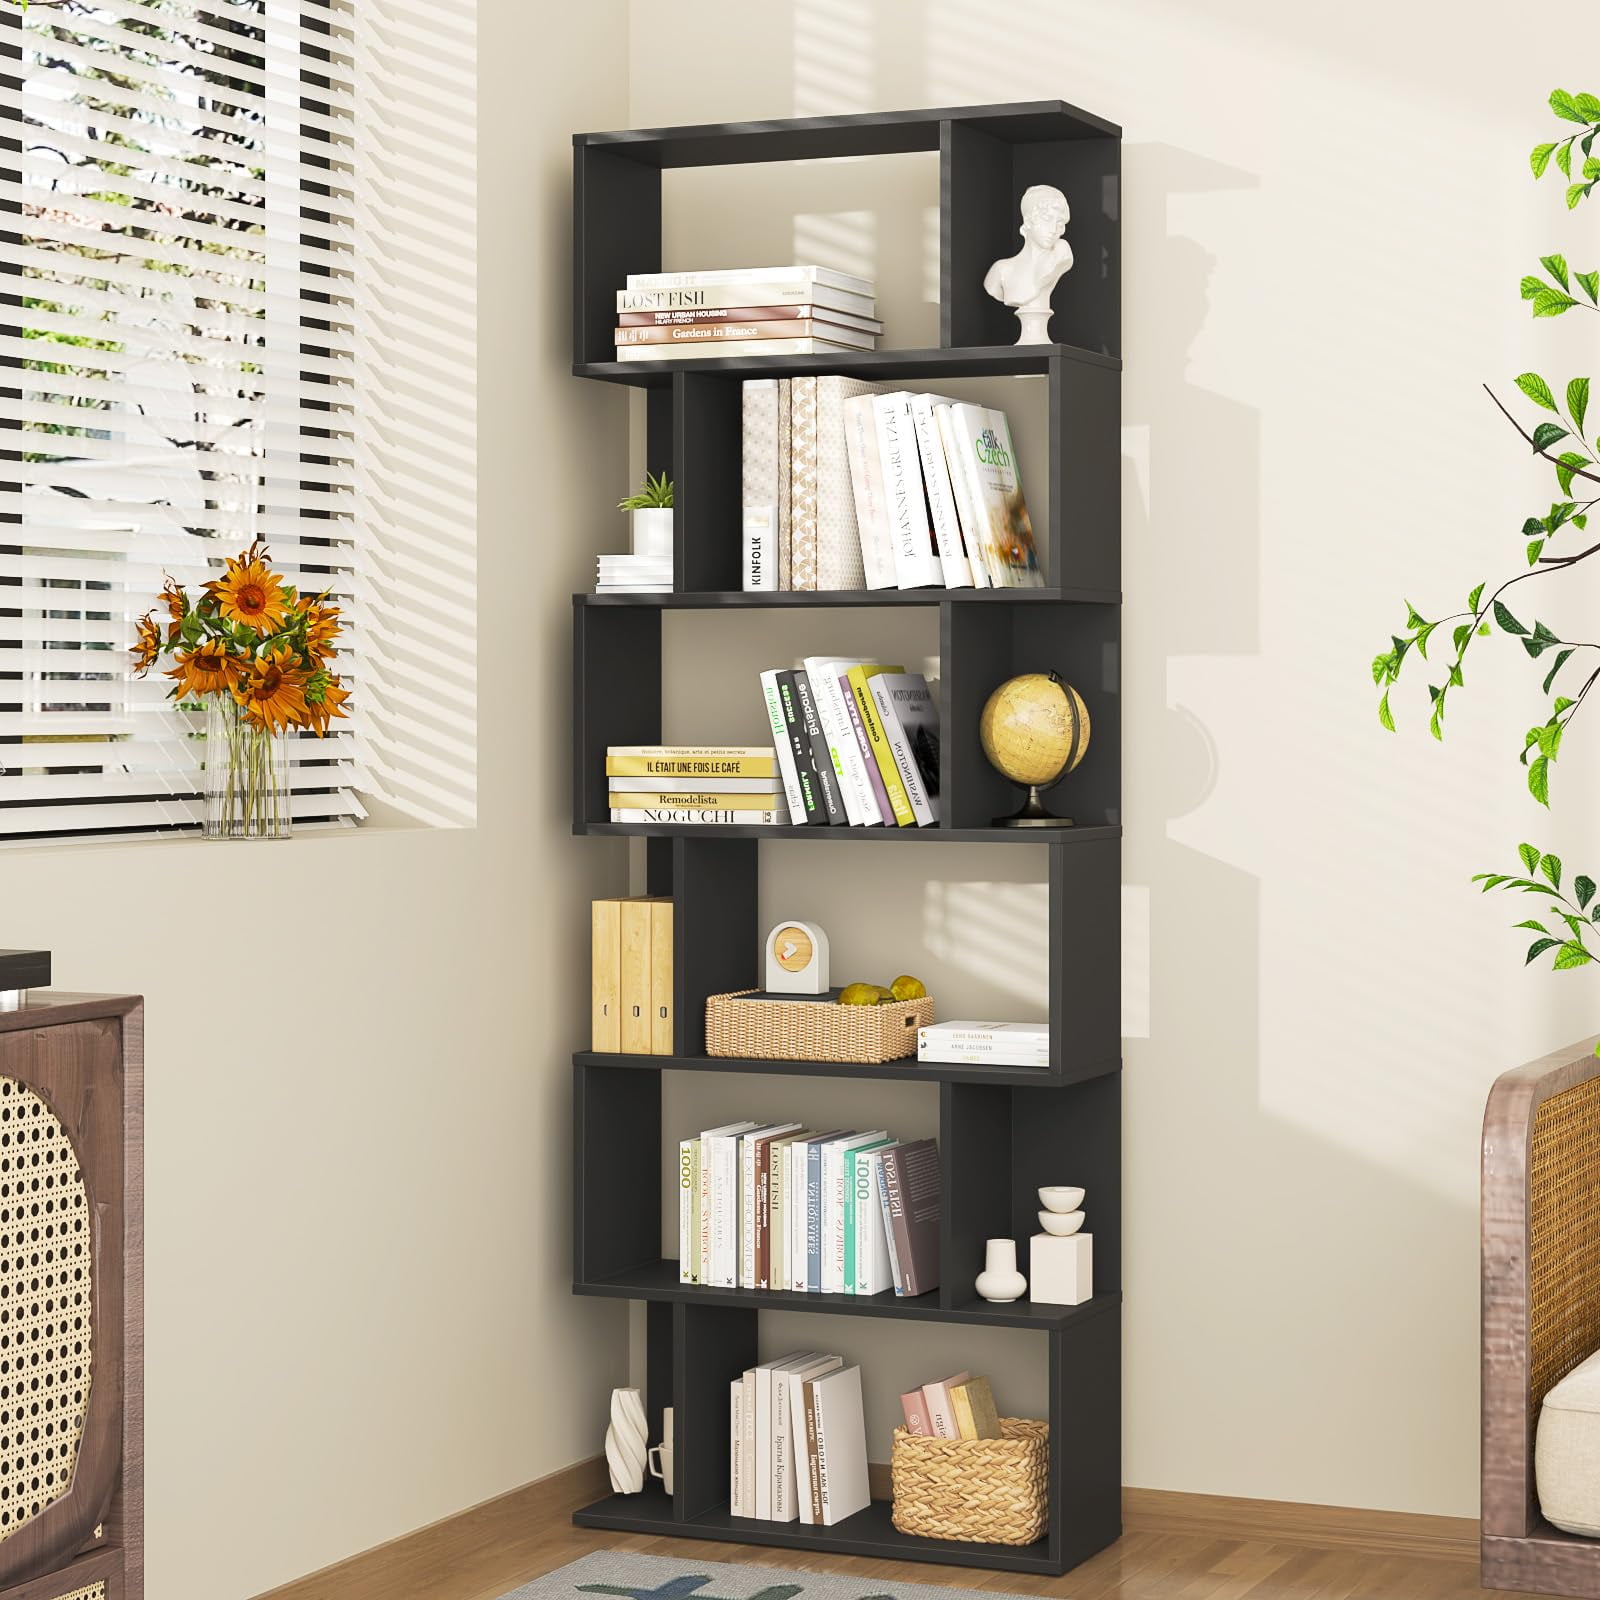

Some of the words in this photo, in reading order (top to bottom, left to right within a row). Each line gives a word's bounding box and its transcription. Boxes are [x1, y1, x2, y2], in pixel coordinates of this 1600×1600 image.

[623, 292, 664, 309] LOST
[669, 290, 704, 307] FISH
[655, 312, 671, 320] NEW
[672, 311, 695, 319] URBAN
[696, 309, 727, 318] HOUSING
[673, 327, 711, 339] Gardens
[713, 328, 723, 338] in
[725, 326, 758, 337] France
[975, 438, 1010, 467] Czech
[751, 537, 762, 586] KINFOLK
[647, 762, 654, 773] IL
[655, 760, 676, 773] ÉTAIT
[677, 762, 691, 773] UNE
[693, 762, 710, 773] FOIS
[711, 762, 720, 773] LE
[721, 760, 740, 773] CAFÉ
[659, 795, 717, 805] Remodelista
[644, 809, 735, 823] NOGUCHI
[681, 1148, 691, 1189] 1000
[771, 1146, 780, 1180] LOST
[771, 1182, 780, 1210] FISH
[775, 1435, 785, 1463] Братья
[817, 1432, 826, 1470] ГОВОРИ
[774, 1464, 785, 1513] Карамазовы
